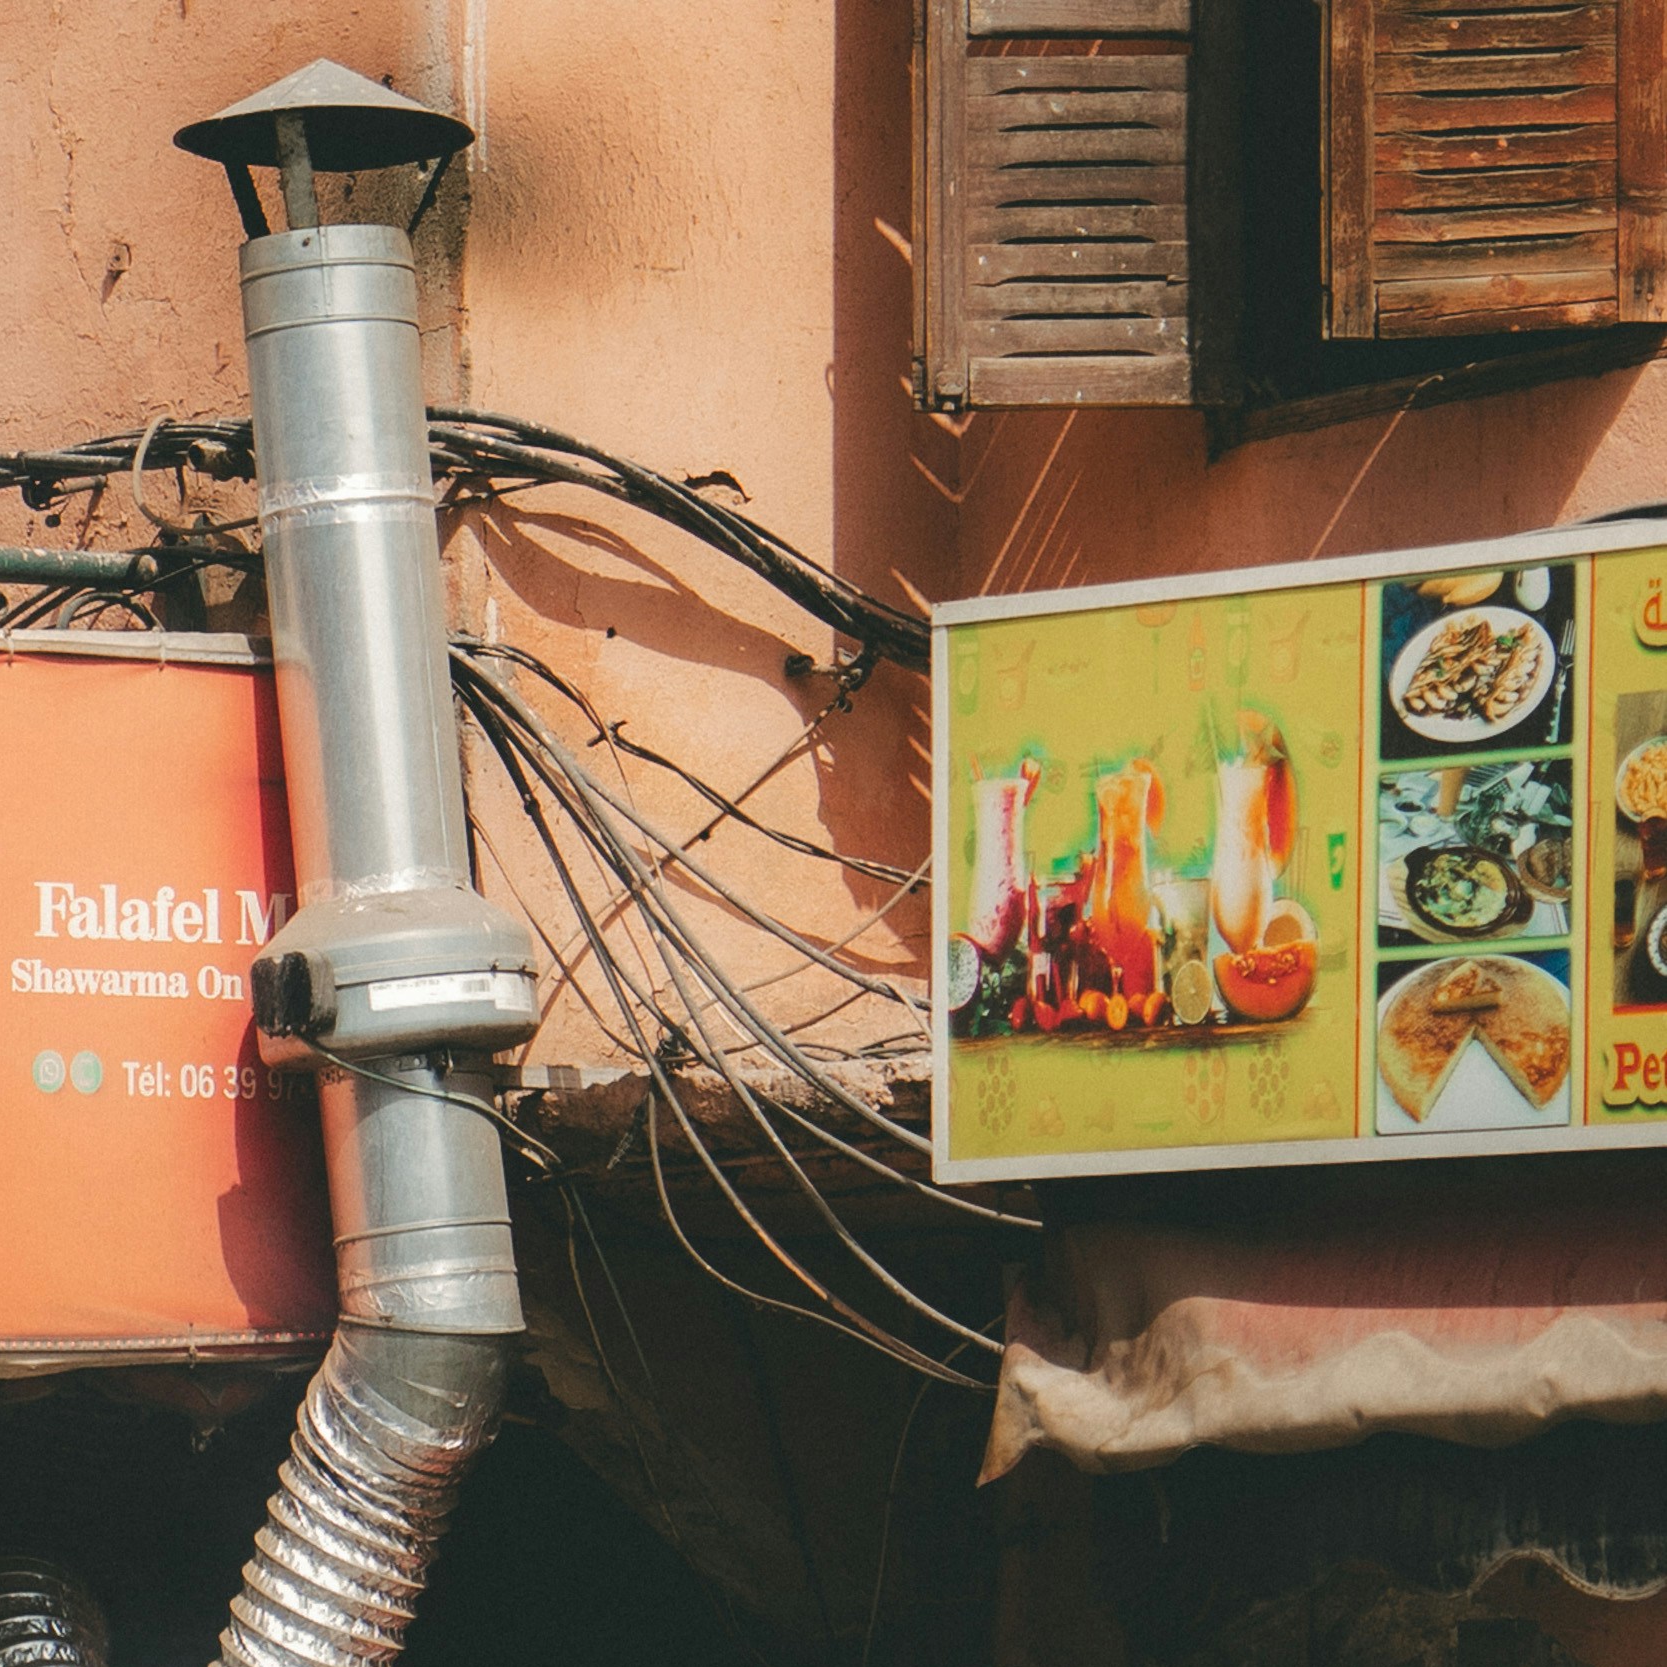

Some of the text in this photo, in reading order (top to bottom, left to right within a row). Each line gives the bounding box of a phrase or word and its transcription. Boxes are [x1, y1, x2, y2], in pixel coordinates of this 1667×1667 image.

[33, 880, 223, 944] Falafel
[10, 958, 245, 1001] Shawarma On
[122, 1060, 172, 1098] Tél:
[180, 1064, 215, 1099] 06
[223, 1066, 257, 1100] 39
